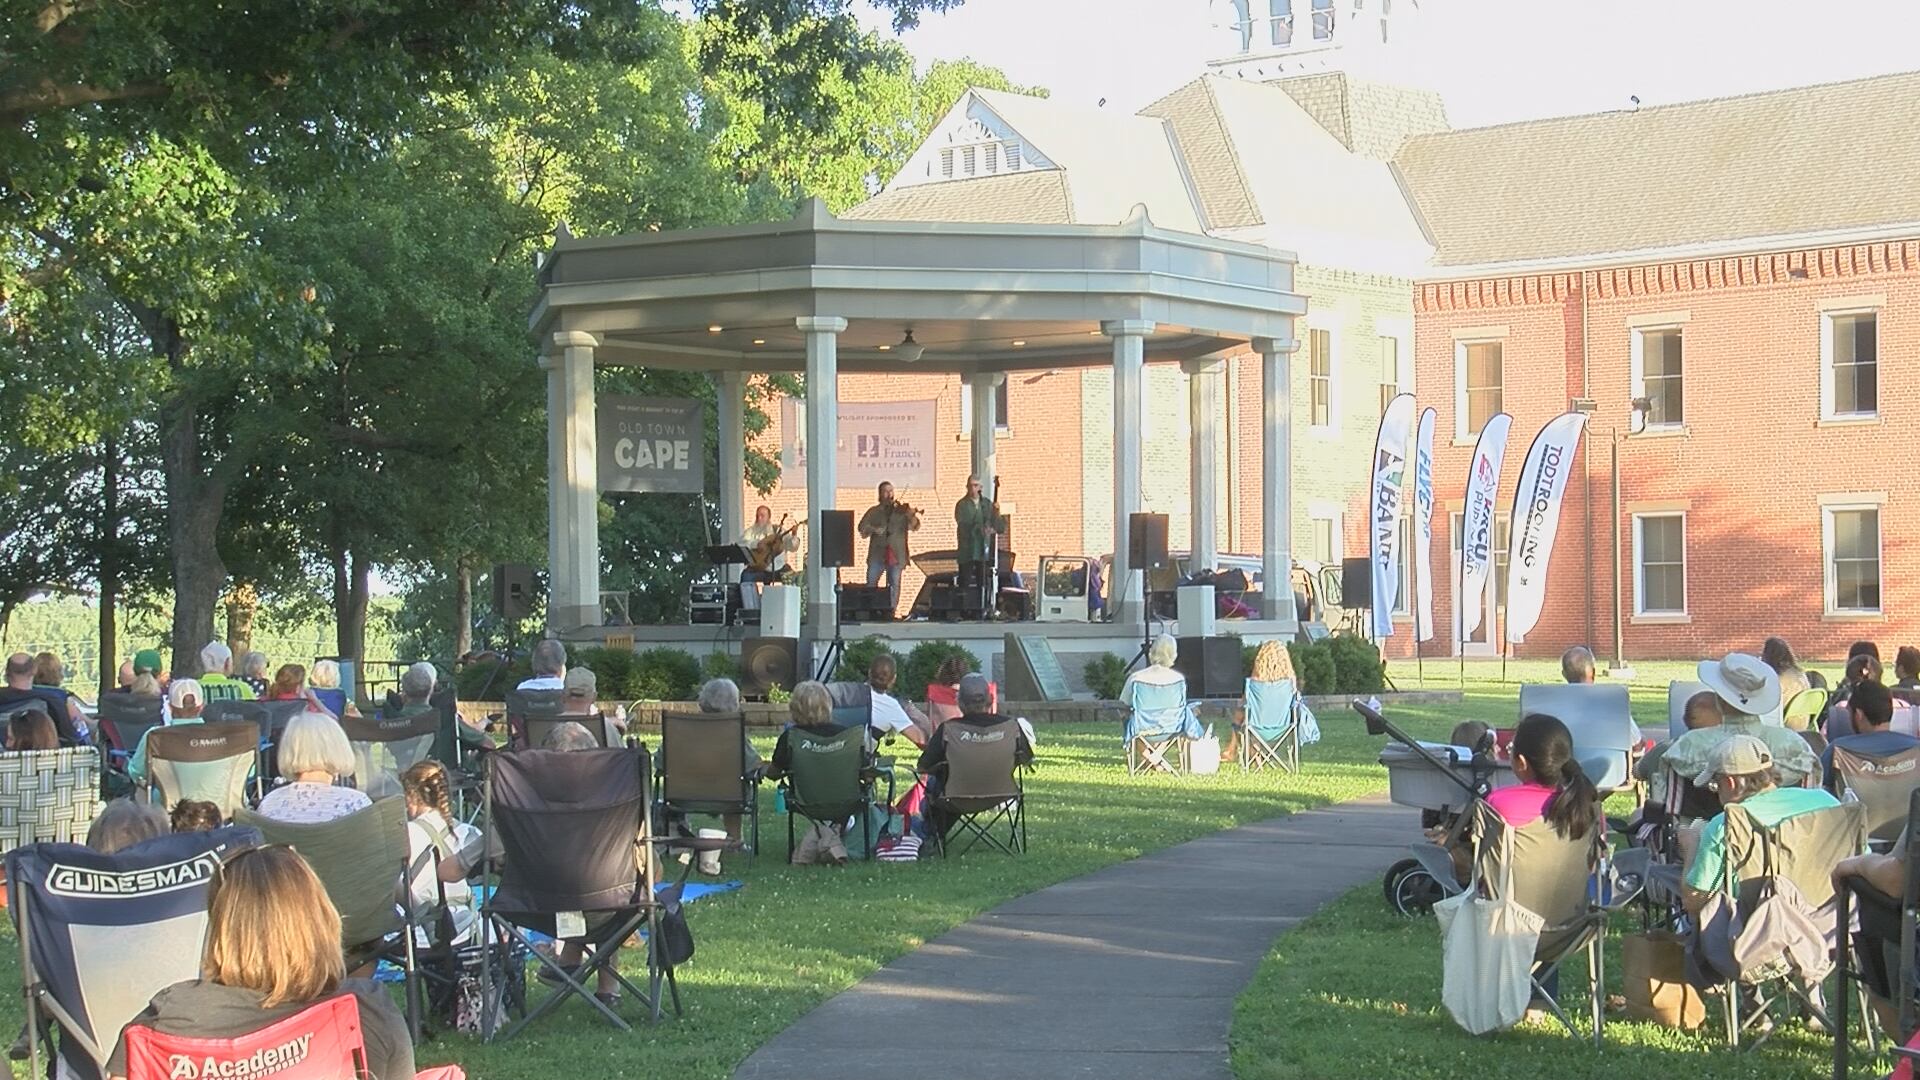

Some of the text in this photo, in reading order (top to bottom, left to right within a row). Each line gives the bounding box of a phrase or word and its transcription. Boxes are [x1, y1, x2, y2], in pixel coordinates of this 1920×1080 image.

[619, 422, 686, 434] OLD TOWN
[884, 435, 910, 446] Saint
[614, 437, 690, 470] CAPE
[884, 447, 921, 458] Francis
[55, 858, 214, 893] GUIDESMAN
[201, 1033, 311, 1078] Academy
